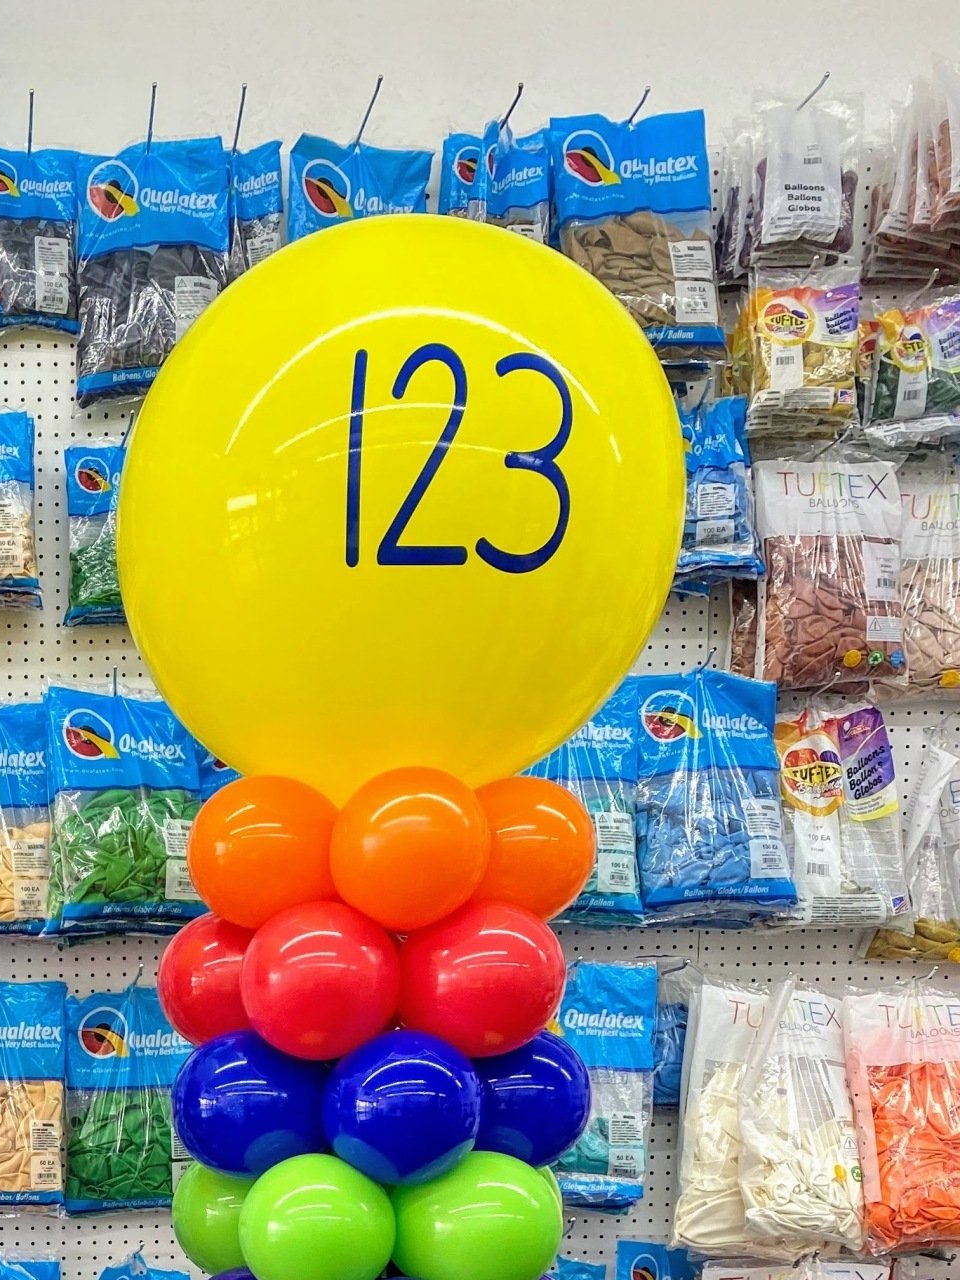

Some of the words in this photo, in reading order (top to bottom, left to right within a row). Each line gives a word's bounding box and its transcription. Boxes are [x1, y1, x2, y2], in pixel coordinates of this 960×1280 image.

[620, 155, 699, 178] Qualatex
[20, 179, 73, 193] Qualatex
[491, 165, 544, 194] Qualatex
[140, 187, 218, 209] Qualatex
[787, 194, 822, 202] Ballons
[788, 204, 821, 212] Globos
[346, 343, 572, 573] 123
[776, 471, 889, 500] TUFTEX
[854, 776, 883, 800] Globos
[684, 885, 769, 897] Balloons/Globos/Ballons
[564, 1008, 645, 1031] Qualatex
[878, 1004, 960, 1031] TUFTE
[144, 1046, 158, 1056] Very
[159, 1047, 174, 1055] Best
